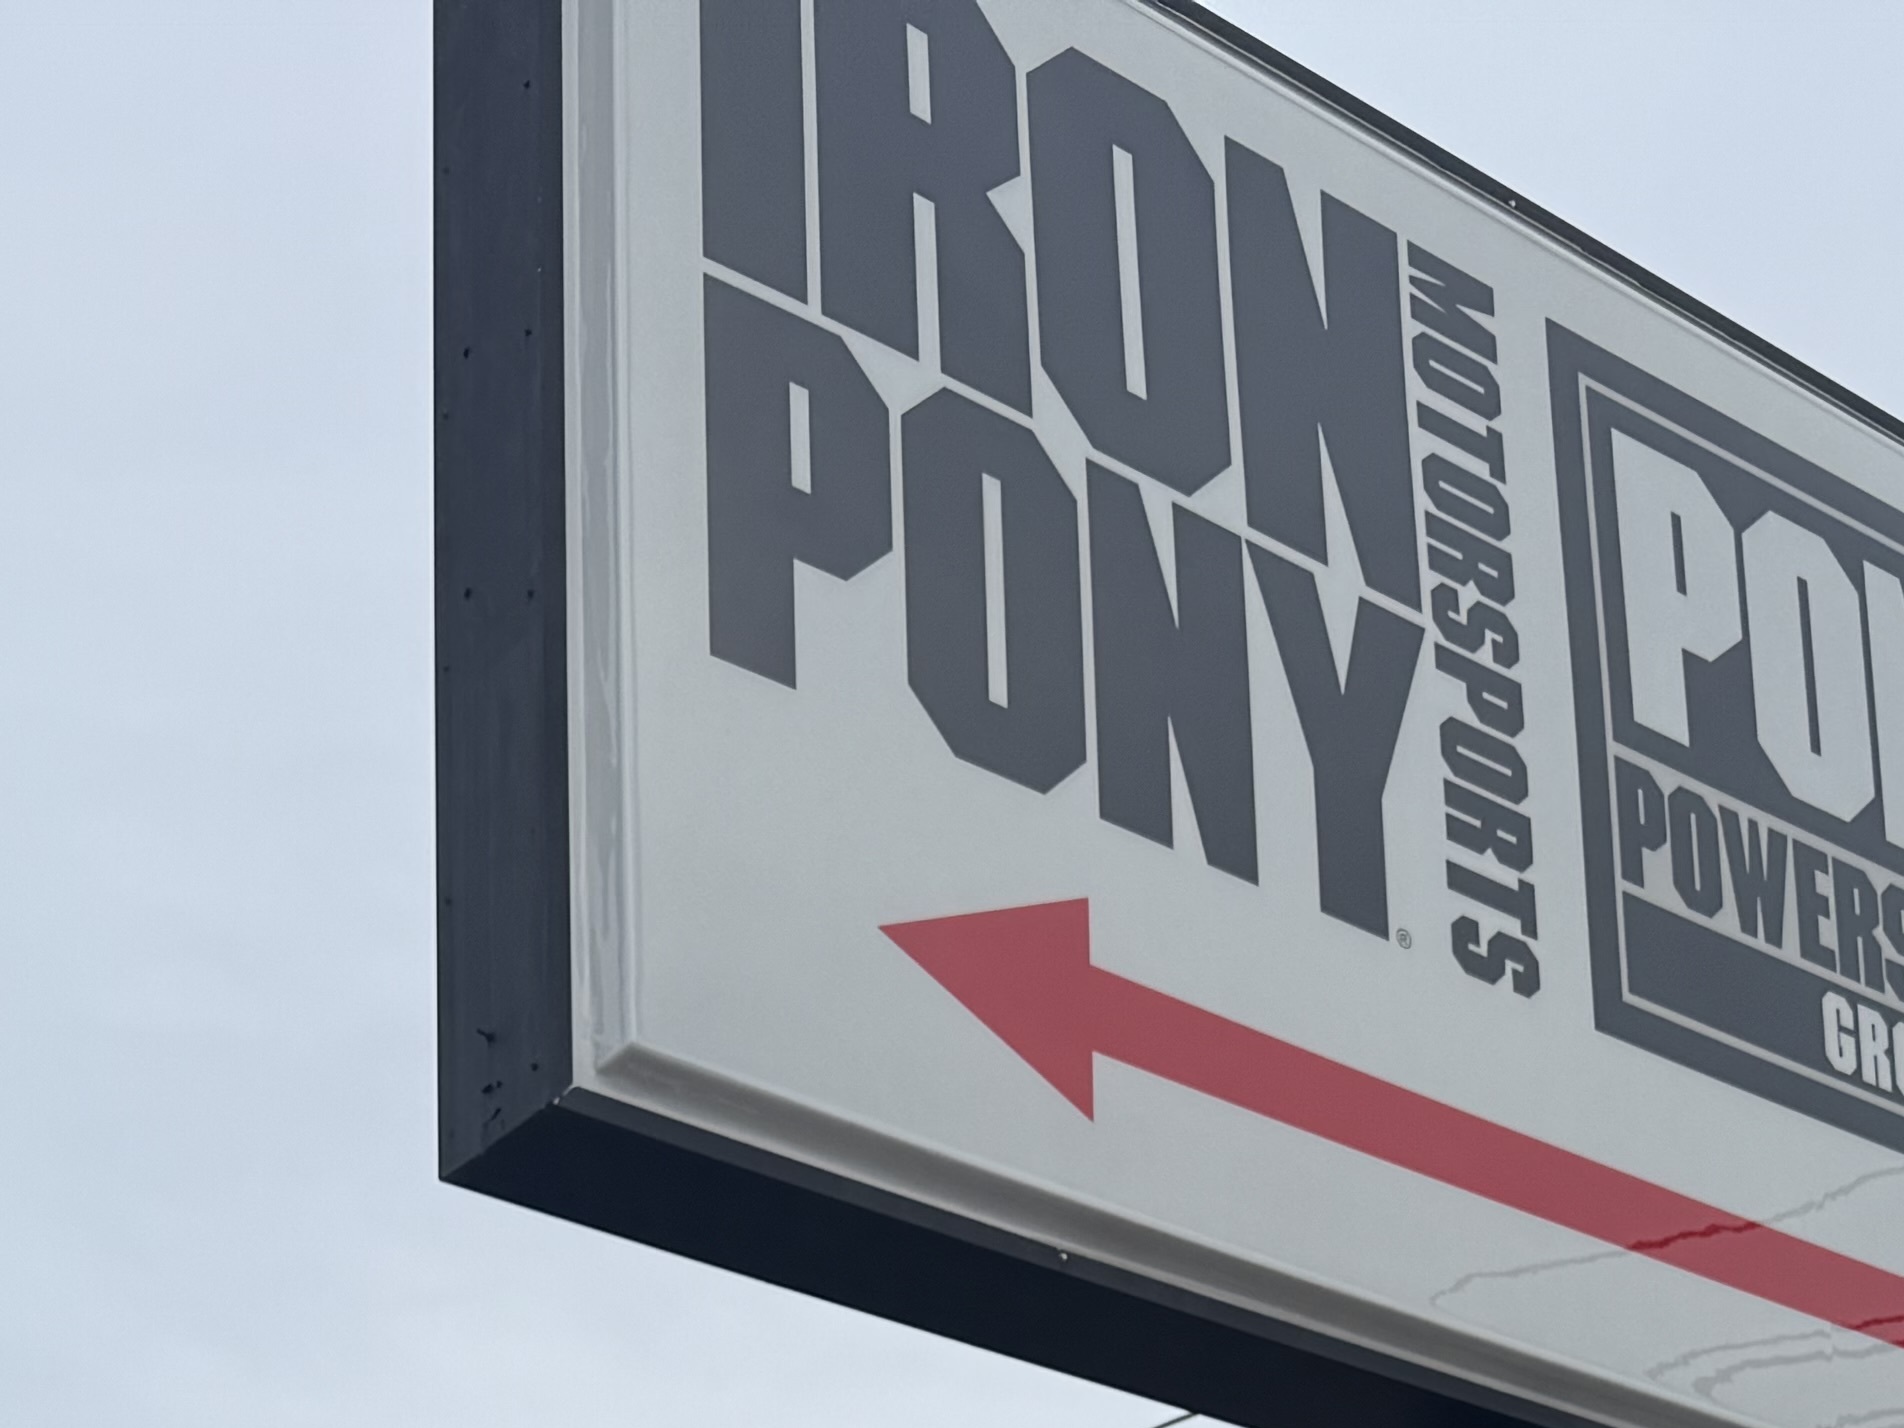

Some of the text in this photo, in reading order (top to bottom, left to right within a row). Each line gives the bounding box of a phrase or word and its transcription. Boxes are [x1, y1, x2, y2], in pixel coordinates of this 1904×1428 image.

[698, 0, 1423, 616] IRON
[702, 271, 1426, 942] PONY
[1406, 239, 1541, 998] MOTORSPORTS
